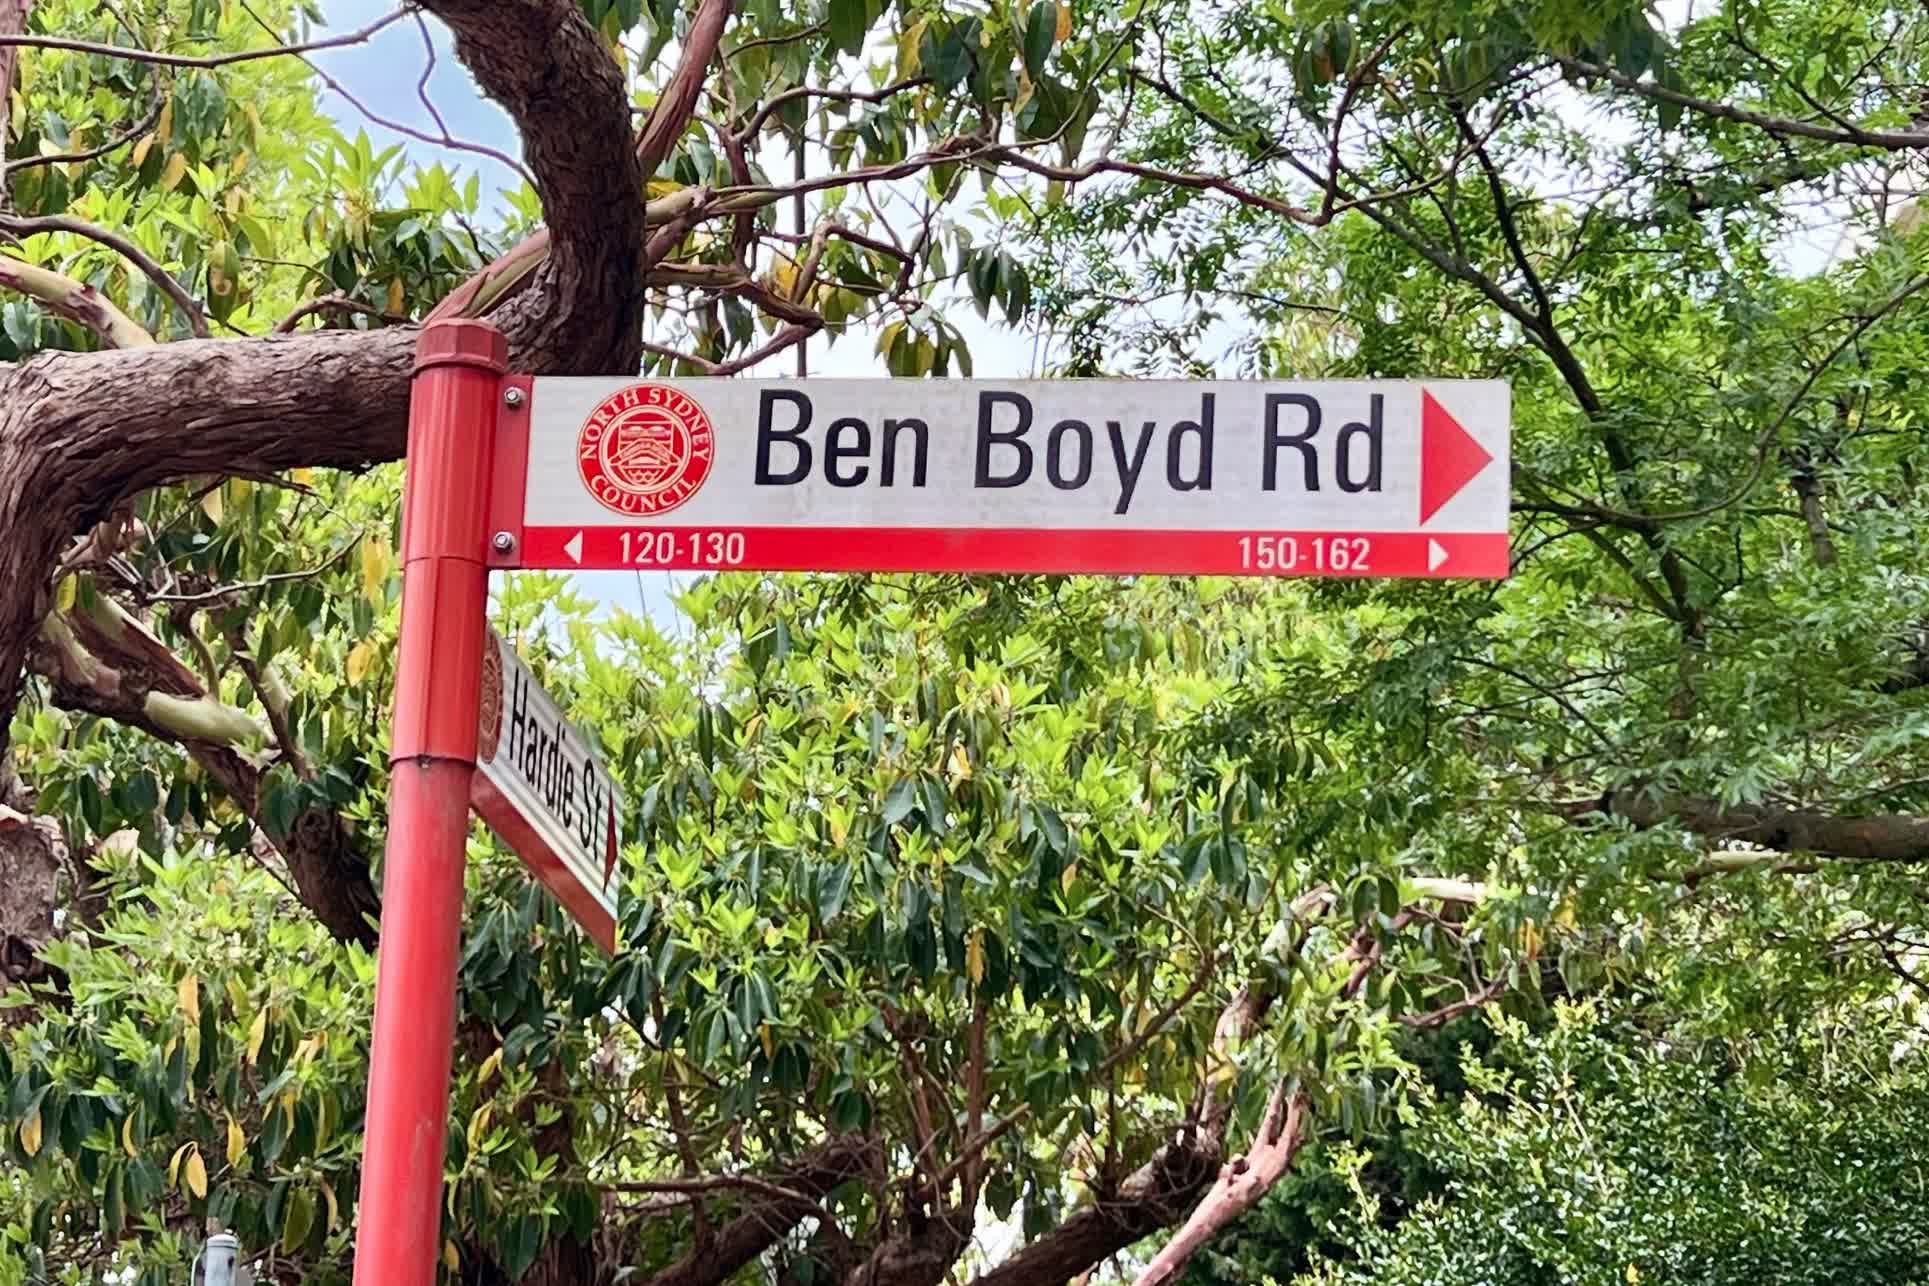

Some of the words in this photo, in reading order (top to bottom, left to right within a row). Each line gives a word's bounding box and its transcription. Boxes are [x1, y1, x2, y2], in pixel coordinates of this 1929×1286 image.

[580, 388, 640, 461] NORTH
[647, 388, 710, 461] SYDNEY
[754, 388, 929, 488] Ben
[975, 390, 1215, 514] Boyd
[1262, 392, 1384, 493] Rd
[591, 475, 697, 513] COUNCIL
[618, 531, 745, 565] 120-130
[1238, 536, 1370, 571] 150-162
[509, 667, 574, 829] Hardie
[580, 757, 602, 862] St
